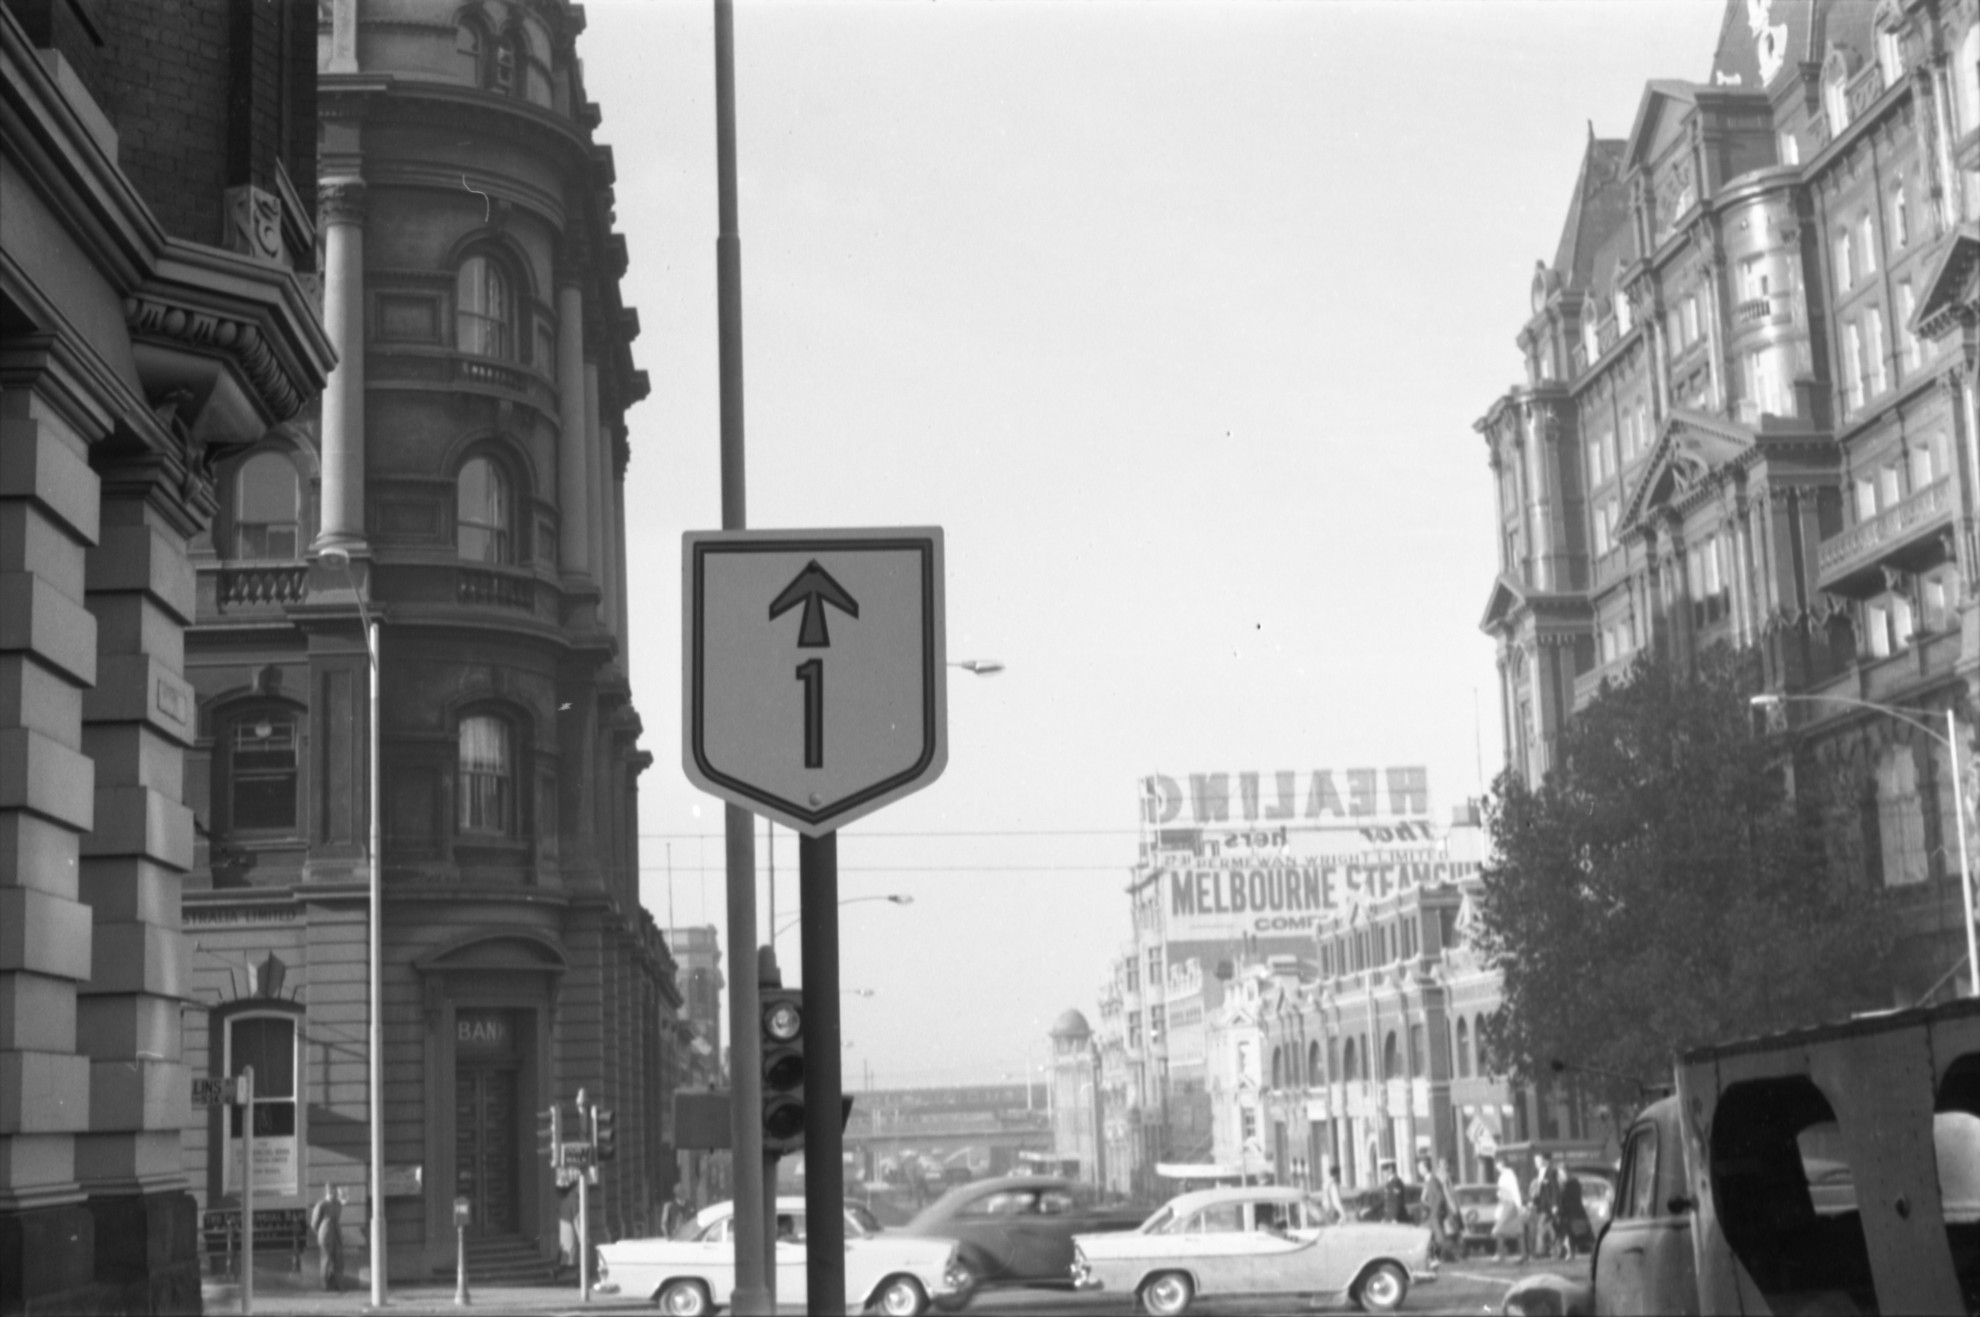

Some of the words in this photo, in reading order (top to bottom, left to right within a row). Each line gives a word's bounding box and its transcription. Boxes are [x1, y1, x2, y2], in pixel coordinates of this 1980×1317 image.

[796, 658, 823, 768] 1
[1171, 867, 1338, 916] MELBOURNE
[1346, 862, 1481, 898] STEAM
[182, 908, 238, 925] STRALIA
[193, 1080, 221, 1095] LINS
